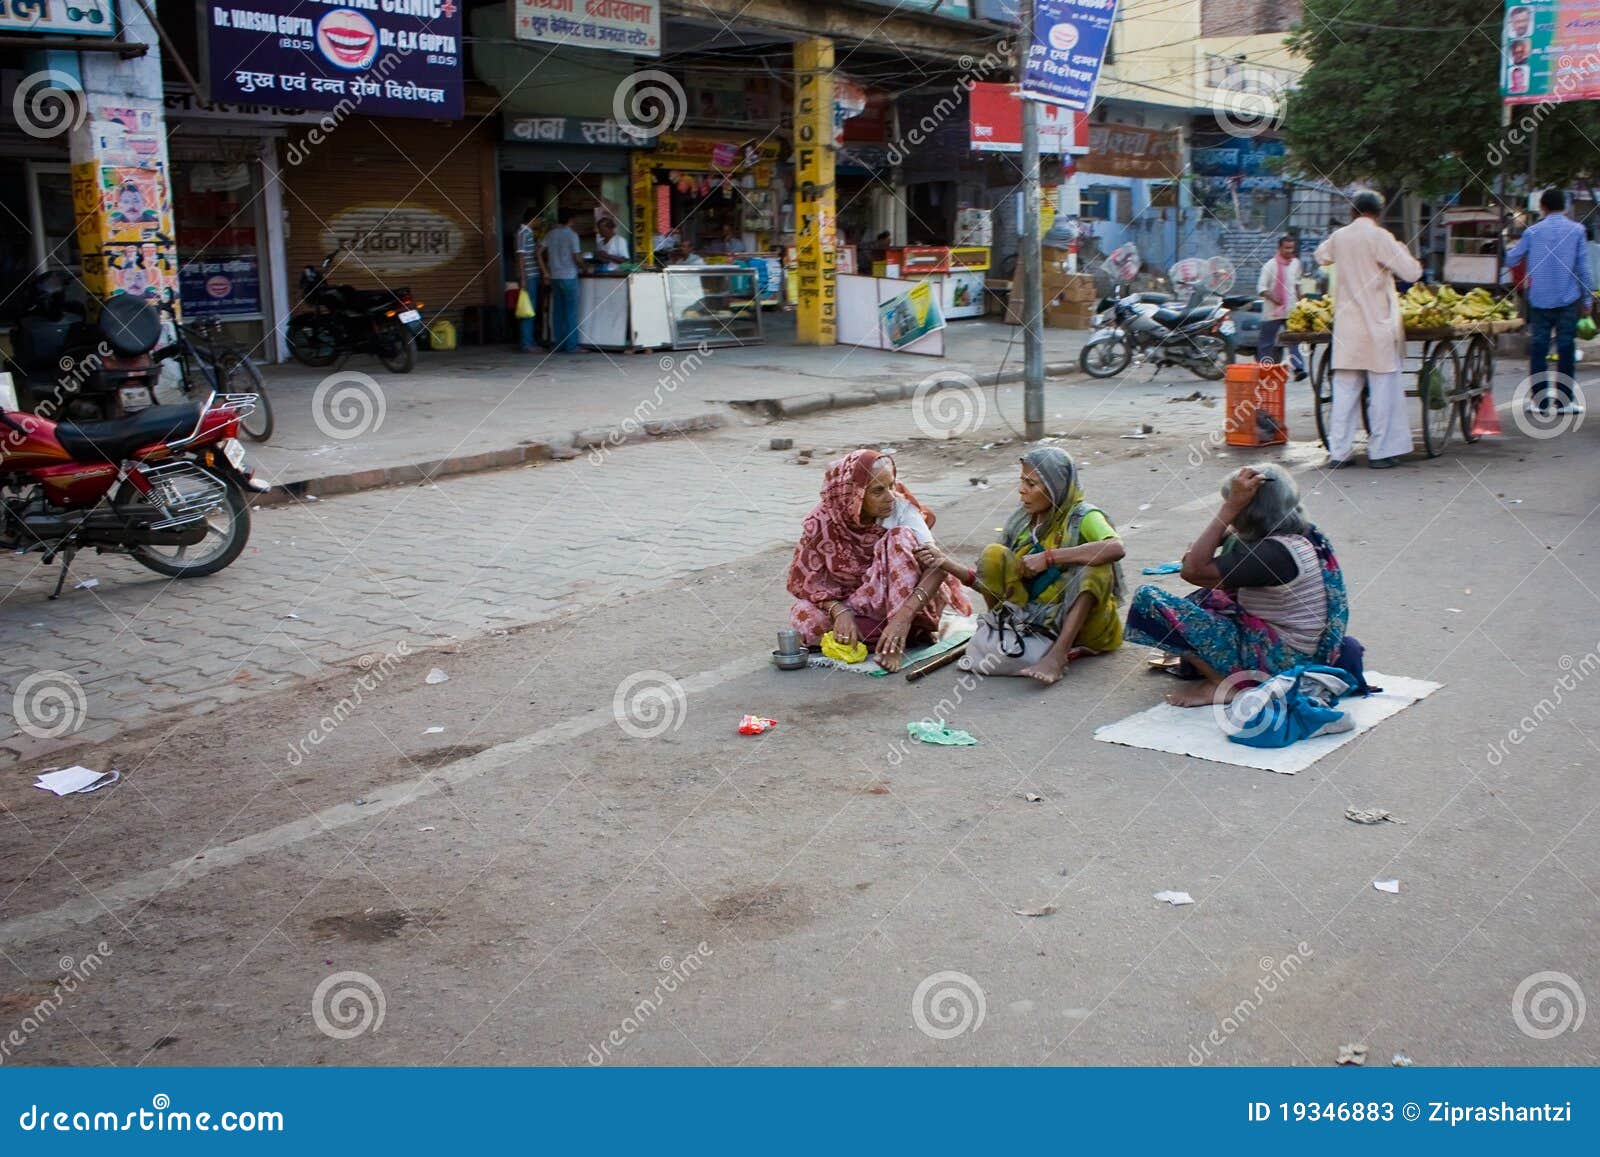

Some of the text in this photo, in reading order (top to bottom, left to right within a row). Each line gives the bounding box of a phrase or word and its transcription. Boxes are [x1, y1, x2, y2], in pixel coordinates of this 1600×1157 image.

[213, 6, 314, 37] Dr. VARSHA GUPTA
[379, 28, 396, 47] Dr.
[418, 33, 457, 53] GUPTA
[235, 70, 275, 92] मुख
[280, 72, 307, 91] एवं
[311, 77, 345, 95] दन्त
[385, 80, 445, 103] विशेषज्ञ
[513, 117, 568, 141] बाबा
